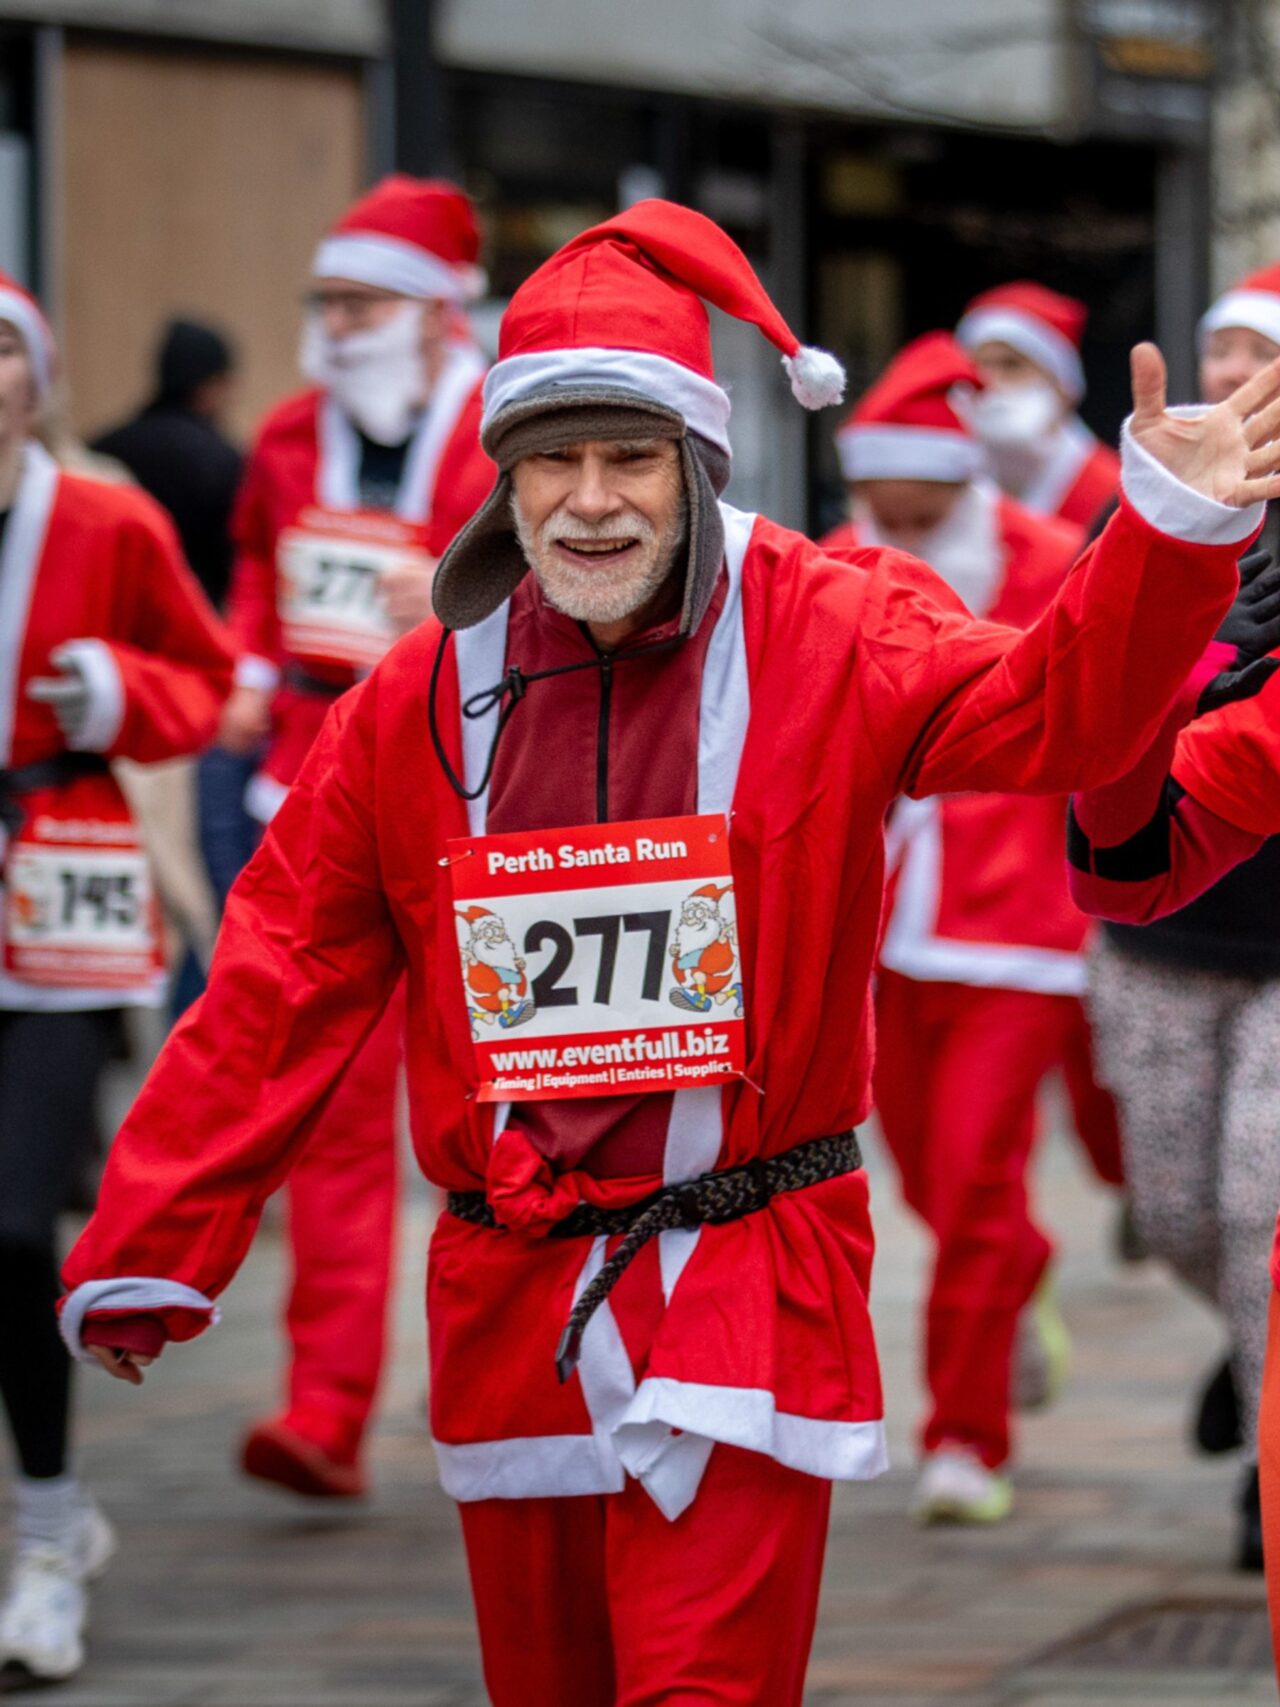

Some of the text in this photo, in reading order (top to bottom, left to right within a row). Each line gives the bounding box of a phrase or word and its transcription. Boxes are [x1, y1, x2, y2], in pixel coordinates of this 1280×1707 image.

[487, 838, 688, 875] Perth Santa Run
[524, 909, 672, 1009] 277
[490, 1028, 729, 1071] www.eventfull.biz
[543, 1072, 609, 1088] Equipment
[617, 1066, 665, 1082] Entries
